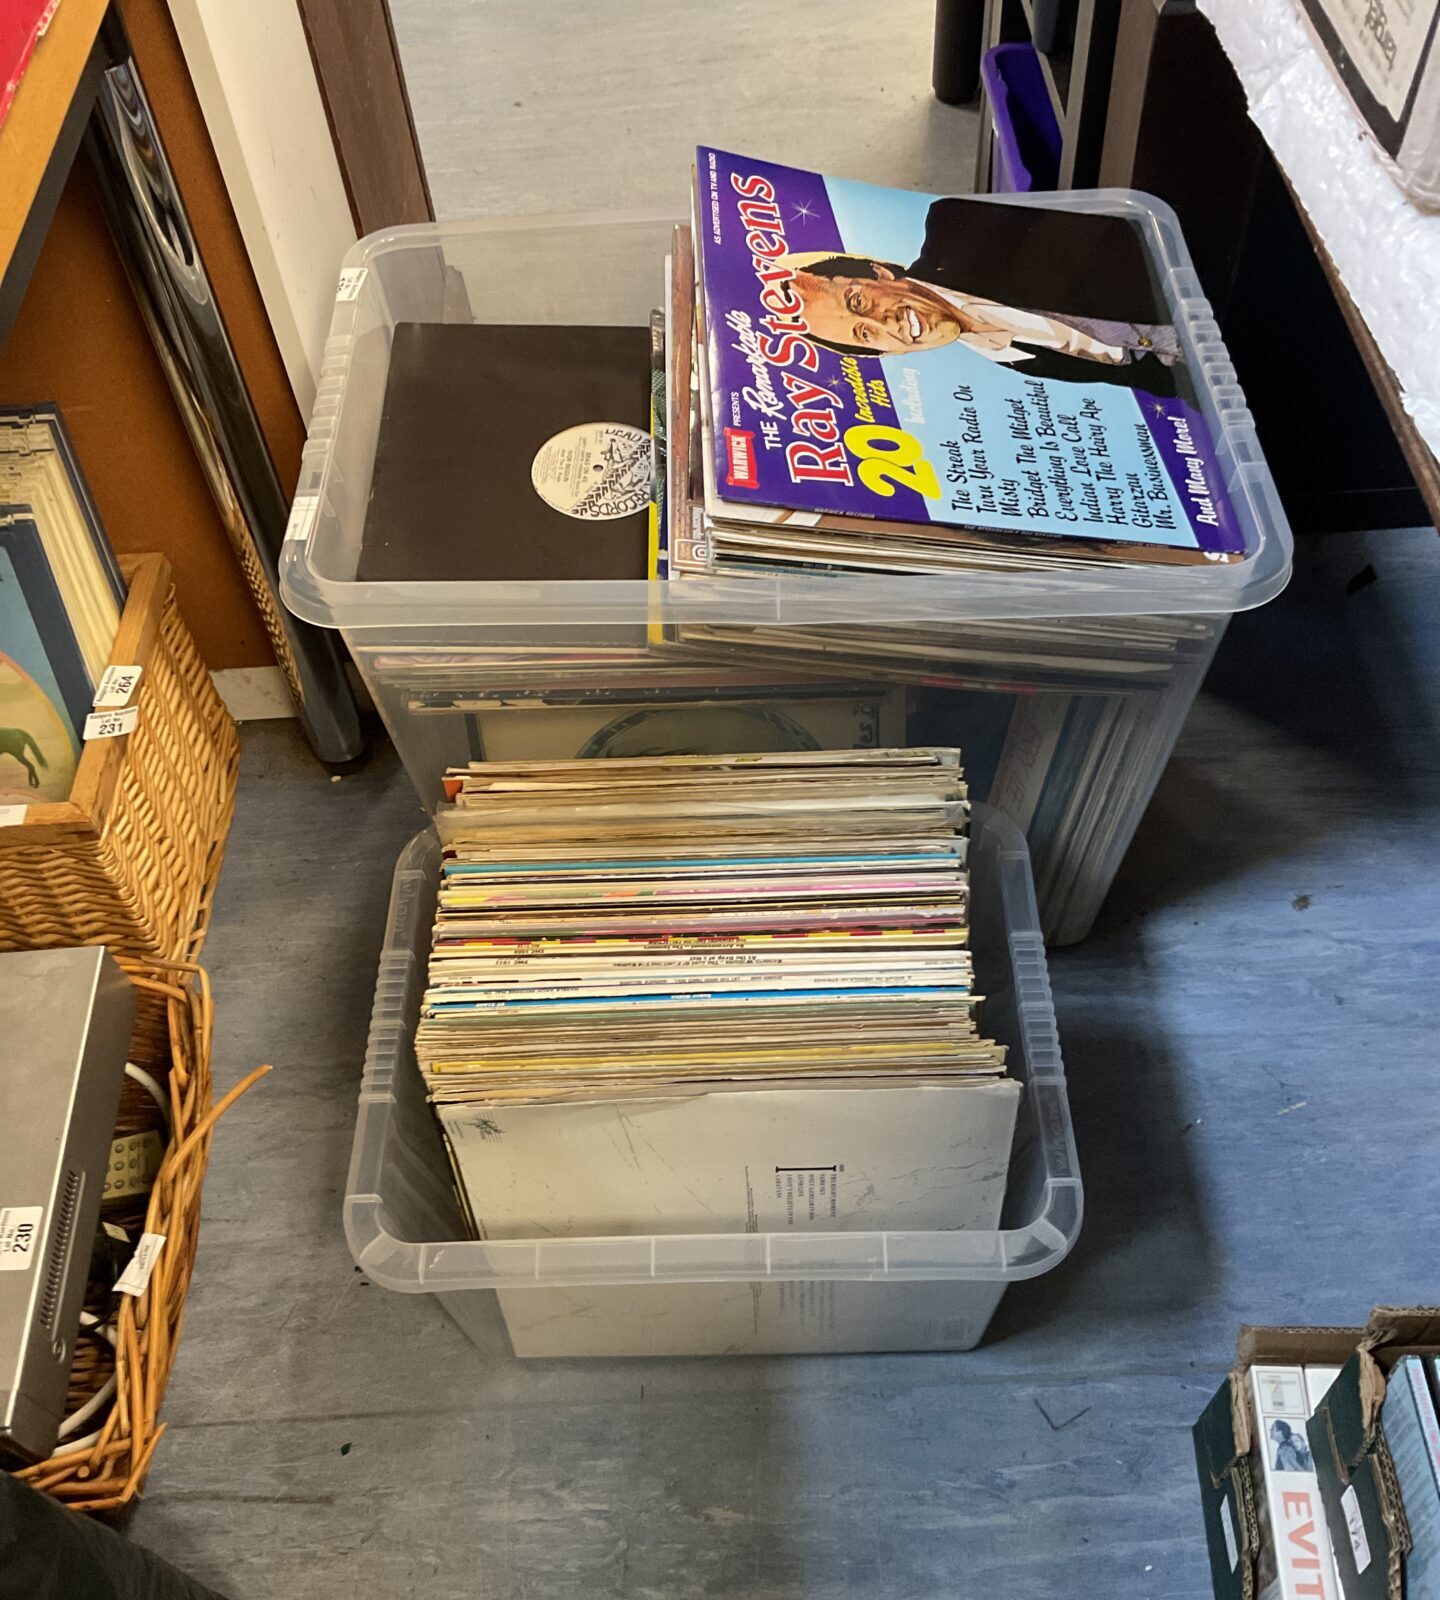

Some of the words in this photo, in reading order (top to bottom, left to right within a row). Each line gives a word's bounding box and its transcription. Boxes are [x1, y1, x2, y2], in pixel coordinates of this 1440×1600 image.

[708, 152, 716, 170] RADIO
[710, 170, 718, 182] AND
[710, 192, 718, 200] ON
[712, 200, 720, 236] ADVERTISED
[714, 235, 722, 245] AS
[730, 172, 819, 372] Stevens
[725, 310, 787, 420] Remarkable
[840, 356, 876, 423] Incredible
[866, 380, 892, 408] Hits
[953, 385, 974, 402] On
[731, 391, 741, 426] PRESENTS
[1004, 398, 1032, 440] Midget
[1024, 380, 1057, 436] Beautiful
[1080, 398, 1103, 420] Ape
[605, 428, 643, 442] DEAD
[760, 421, 782, 450] THE
[786, 371, 854, 487] Ray
[959, 406, 983, 444] Radio
[1057, 414, 1082, 443] Call
[1088, 424, 1110, 458] Hairy
[1167, 416, 1197, 454] More!
[731, 435, 749, 480] WARWICK
[843, 424, 942, 500] 20
[940, 440, 968, 484] Streak
[1016, 444, 1036, 464] The
[1040, 442, 1060, 452] Is
[1070, 446, 1092, 477] Love
[1134, 423, 1168, 501] Businessman
[968, 449, 994, 480] Your
[1096, 462, 1116, 482] The
[1184, 457, 1210, 495] Many
[952, 490, 973, 510] The
[976, 486, 998, 513] Turn
[998, 478, 1023, 516] Misty
[1021, 470, 1050, 518] Bridget
[1047, 456, 1078, 522] Everything
[1080, 482, 1104, 523] Indian
[1126, 472, 1153, 528] Gitarzan
[1106, 487, 1129, 526] Harry
[1153, 504, 1177, 530] Mr.
[1190, 498, 1220, 526] And
[116, 676, 134, 694] 264
[98, 722, 122, 734] 231
[12, 1223, 34, 1253] 230
